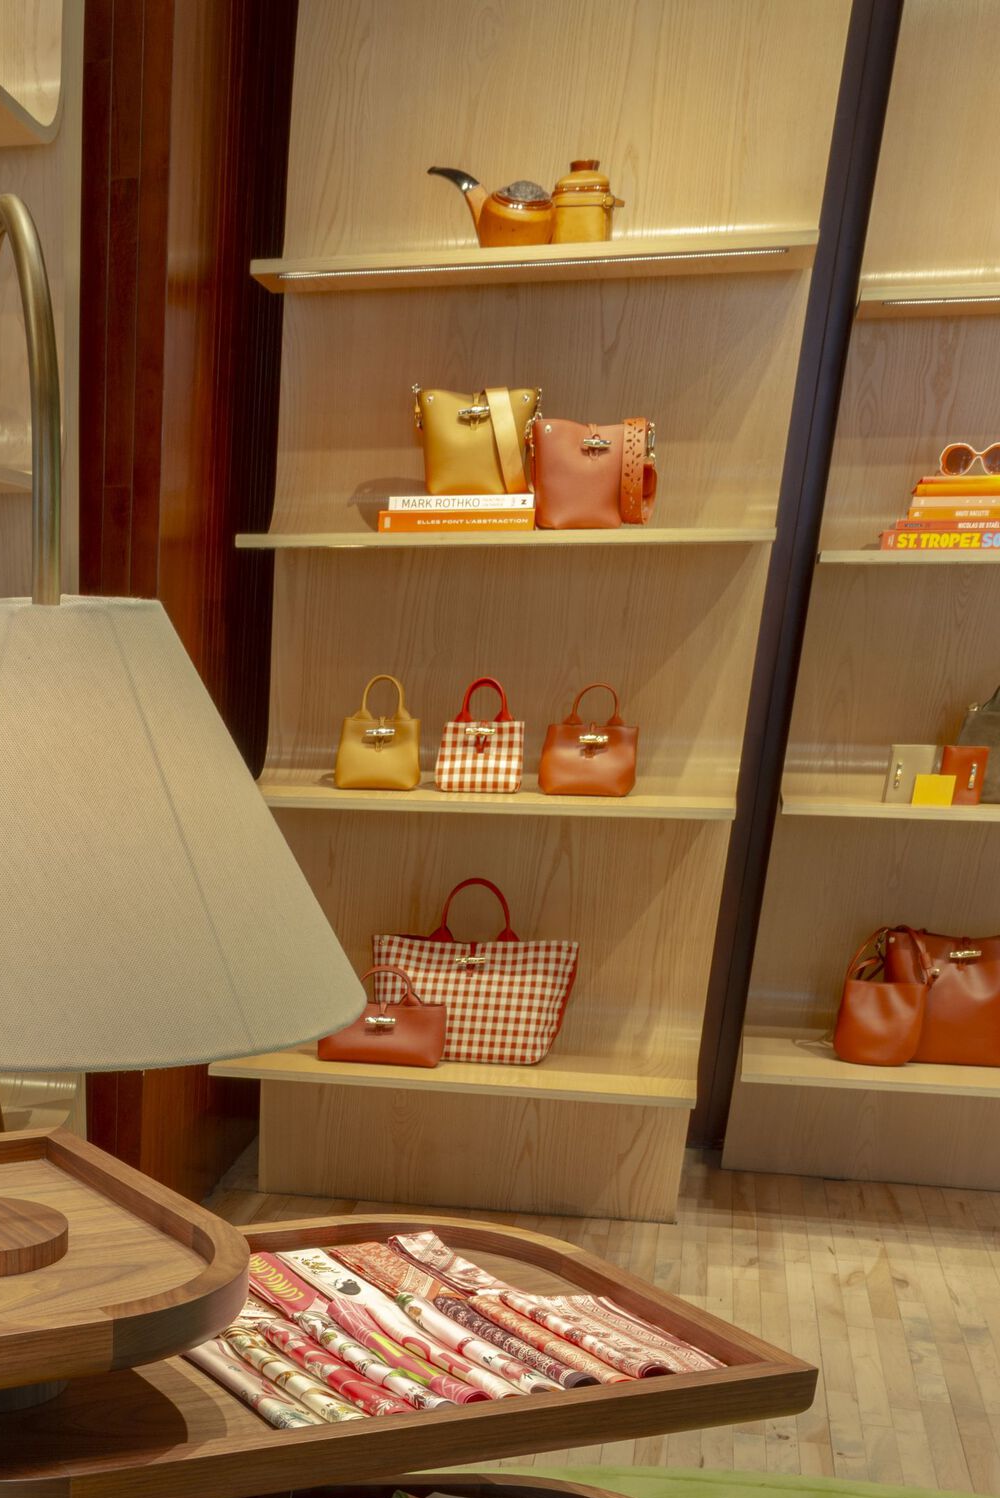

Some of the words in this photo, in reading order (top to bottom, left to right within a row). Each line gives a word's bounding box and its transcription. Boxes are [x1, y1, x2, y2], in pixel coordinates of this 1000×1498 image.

[401, 498, 433, 509] MARK
[435, 498, 480, 508] ROTHKO
[896, 532, 918, 548] ST.
[919, 532, 981, 548] TROPEZ
